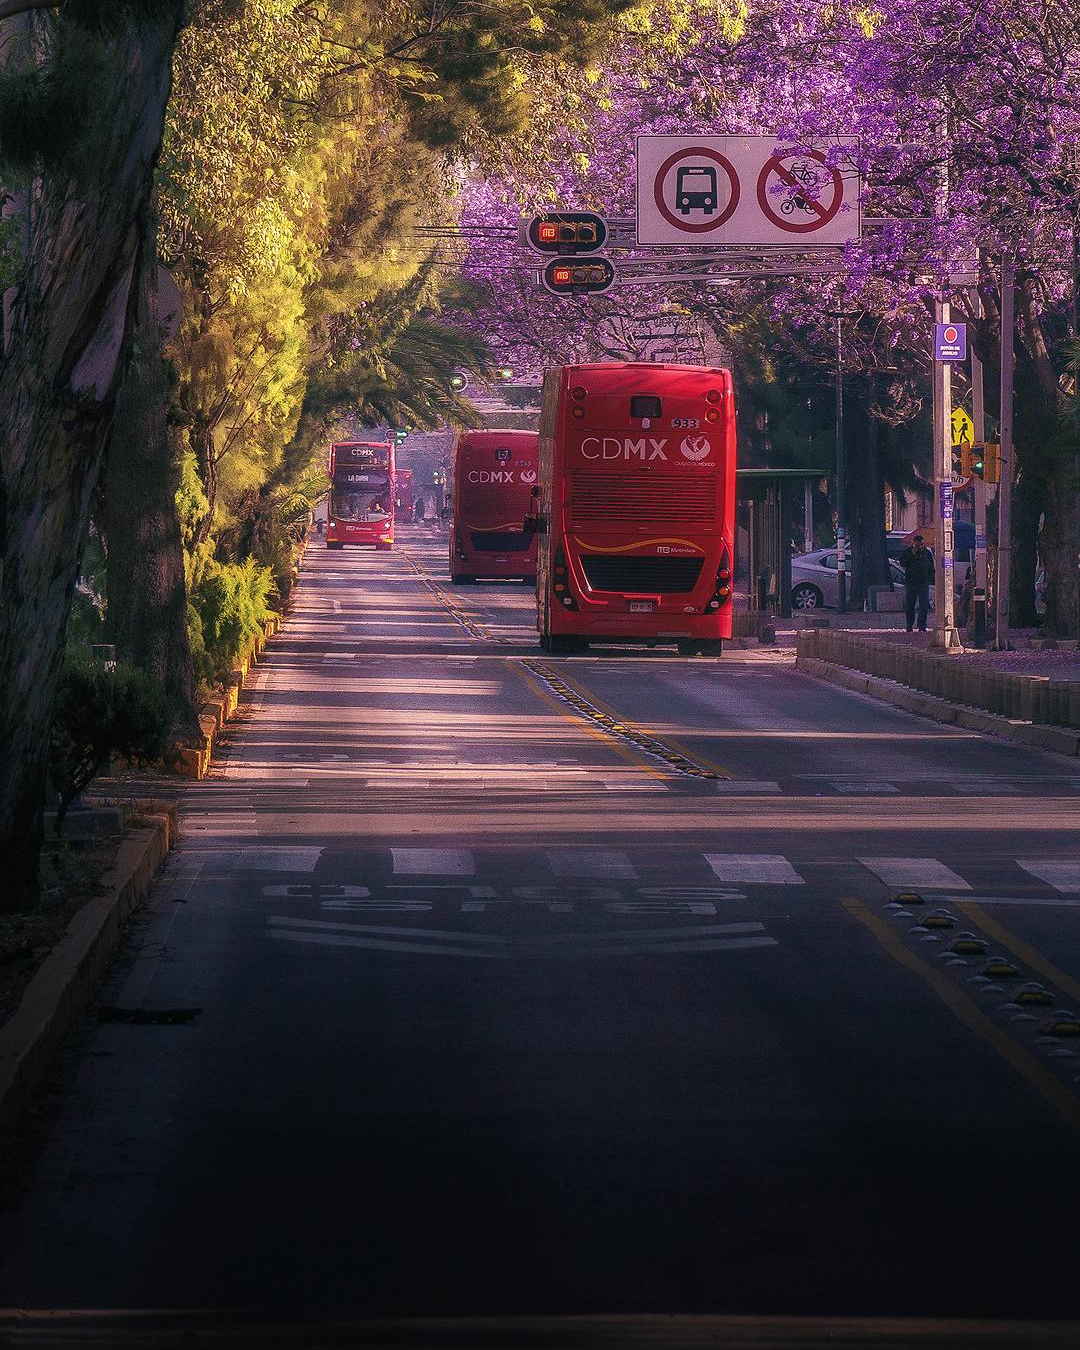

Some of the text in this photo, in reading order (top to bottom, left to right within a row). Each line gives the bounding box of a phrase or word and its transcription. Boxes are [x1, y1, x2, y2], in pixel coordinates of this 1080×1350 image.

[674, 418, 697, 428] 933
[580, 437, 668, 461] CDMX
[498, 450, 509, 460] L-7
[468, 470, 514, 483] CDMX
